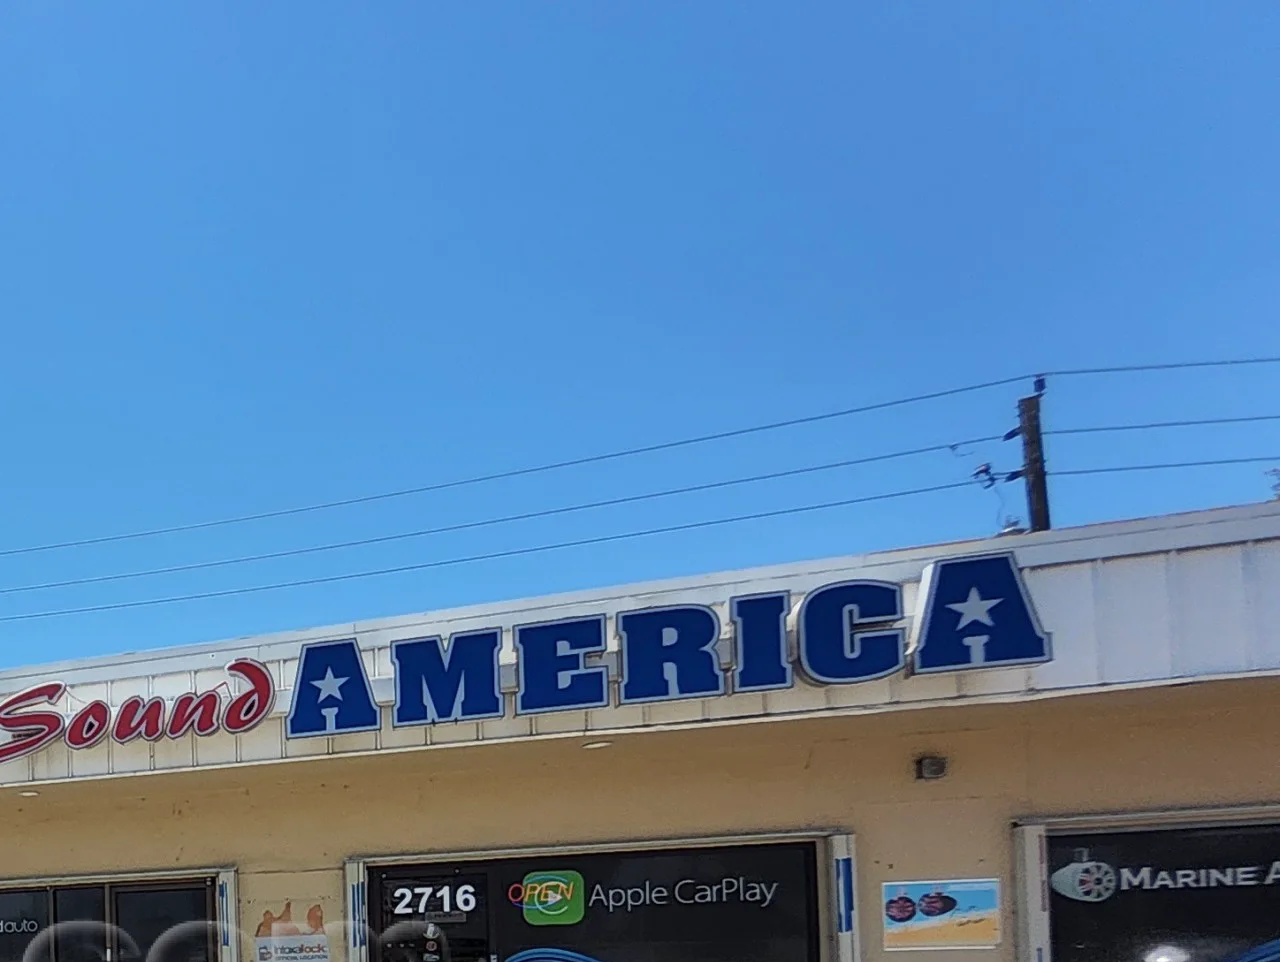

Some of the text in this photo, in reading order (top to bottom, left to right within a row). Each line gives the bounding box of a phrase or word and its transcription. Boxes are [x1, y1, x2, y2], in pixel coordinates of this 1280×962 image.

[286, 550, 1053, 740] AMERICA
[508, 882, 574, 902] OPEN
[1119, 866, 1260, 890] MARINE
[393, 884, 476, 914] 2716
[589, 876, 778, 912] Apple CarPlay
